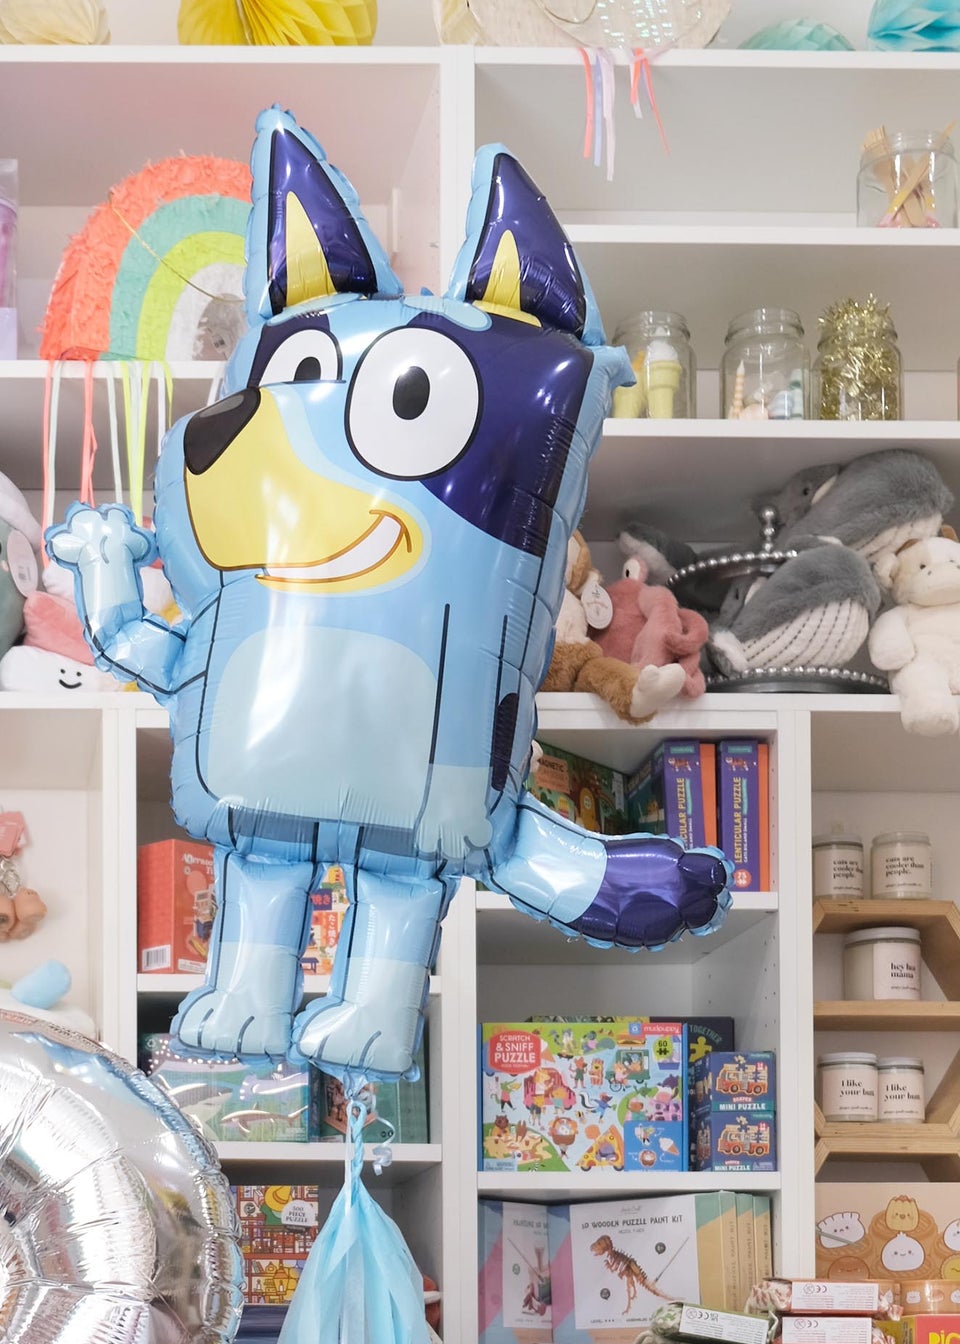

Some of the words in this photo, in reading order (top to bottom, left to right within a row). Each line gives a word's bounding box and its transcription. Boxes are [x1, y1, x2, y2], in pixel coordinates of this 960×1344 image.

[676, 777, 687, 810] PUZZLE
[732, 776, 742, 810] PUZZLE
[733, 811, 743, 864] LENTICULAR
[499, 1034, 532, 1042] SCRATCH
[689, 1024, 723, 1045] TOGETHER
[495, 1042, 504, 1052] &
[505, 1042, 534, 1052] SNIFF
[658, 1040, 668, 1048] 60
[494, 1052, 537, 1064] PUZZLE
[846, 1079, 863, 1088] like
[890, 1083, 907, 1092] like
[839, 1089, 861, 1098] your
[884, 1093, 906, 1102] your
[719, 1103, 736, 1111] MINI
[591, 1220, 620, 1229] WOODEN
[621, 1218, 648, 1227] PUZZLE
[649, 1216, 669, 1225] PAINT
[671, 1214, 683, 1223] KIT
